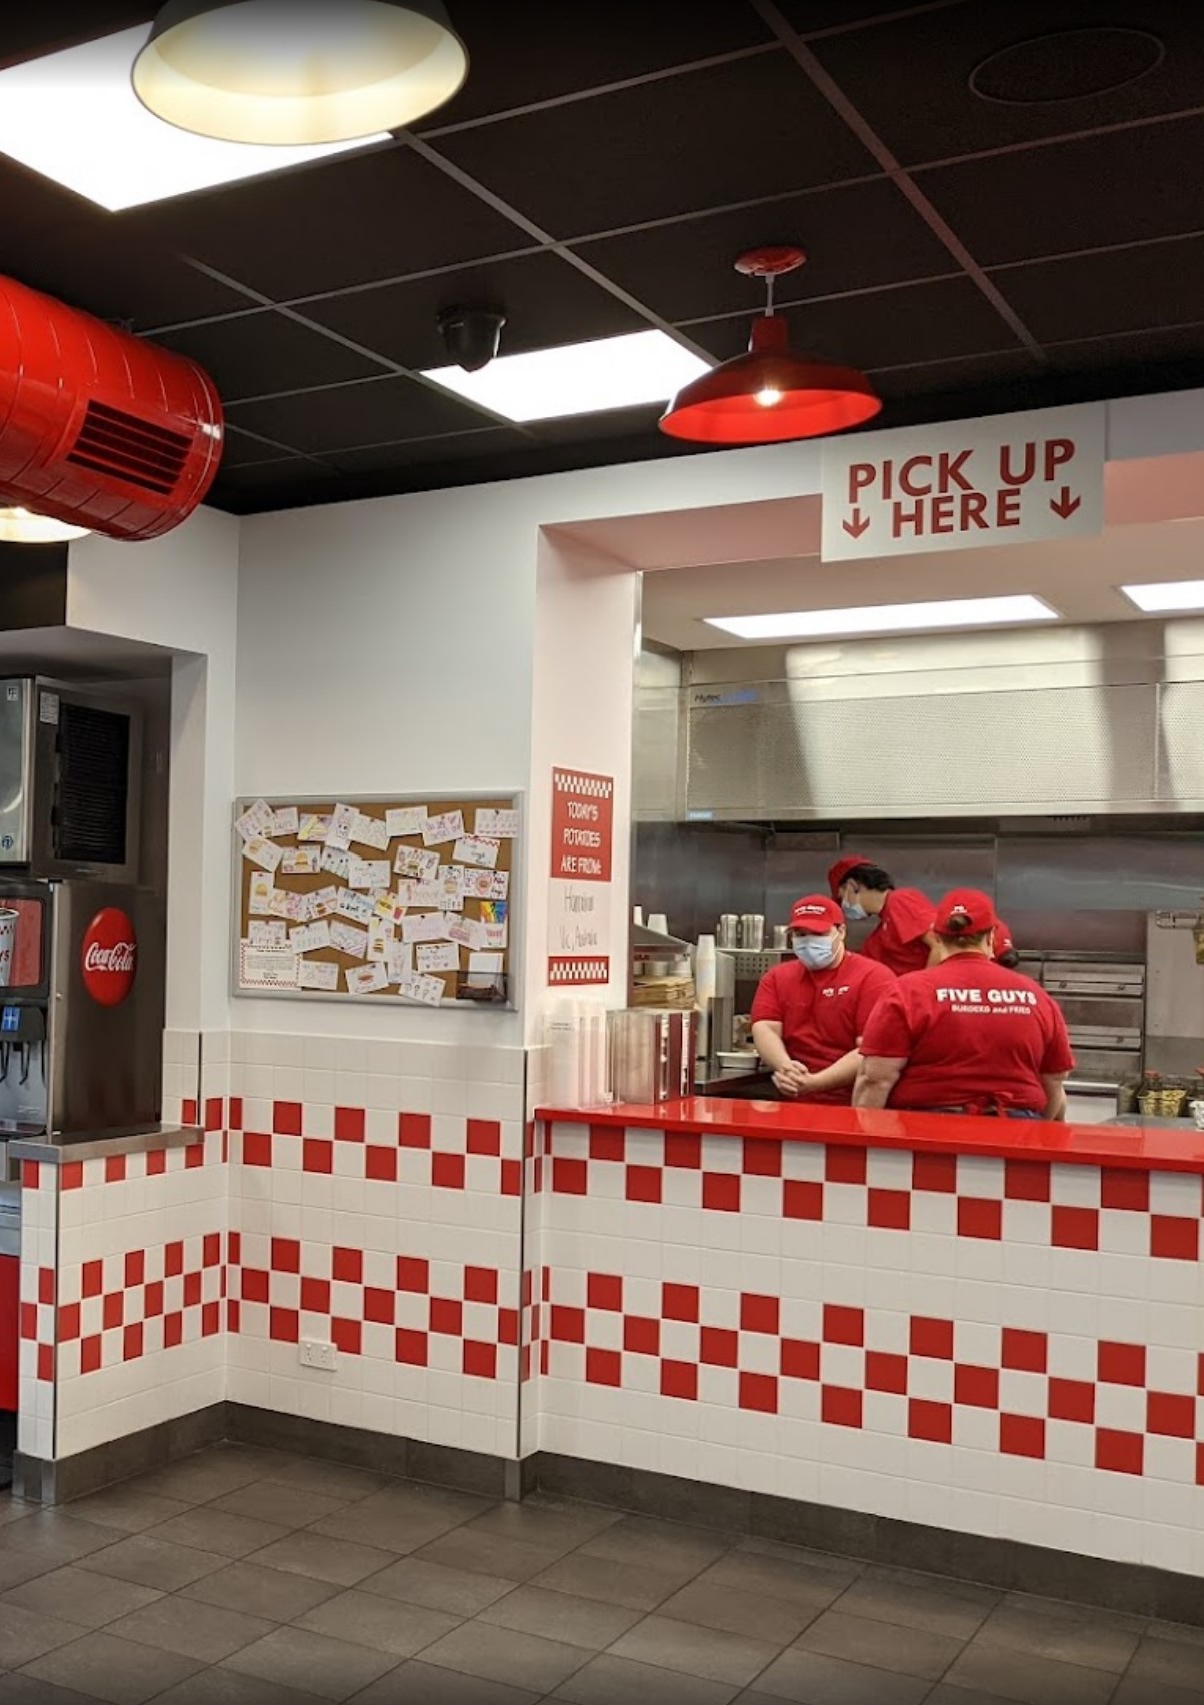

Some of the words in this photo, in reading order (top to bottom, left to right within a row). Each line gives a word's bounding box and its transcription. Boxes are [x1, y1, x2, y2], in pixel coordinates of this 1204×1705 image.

[848, 449, 975, 504] PICK
[999, 438, 1076, 486] UP
[892, 487, 1022, 538] HERE
[566, 800, 598, 821] TODAY'S
[563, 827, 601, 848] POTATOES
[560, 854, 577, 872] ARE
[936, 988, 982, 1003] FIVE
[987, 989, 1037, 1006] GUYS
